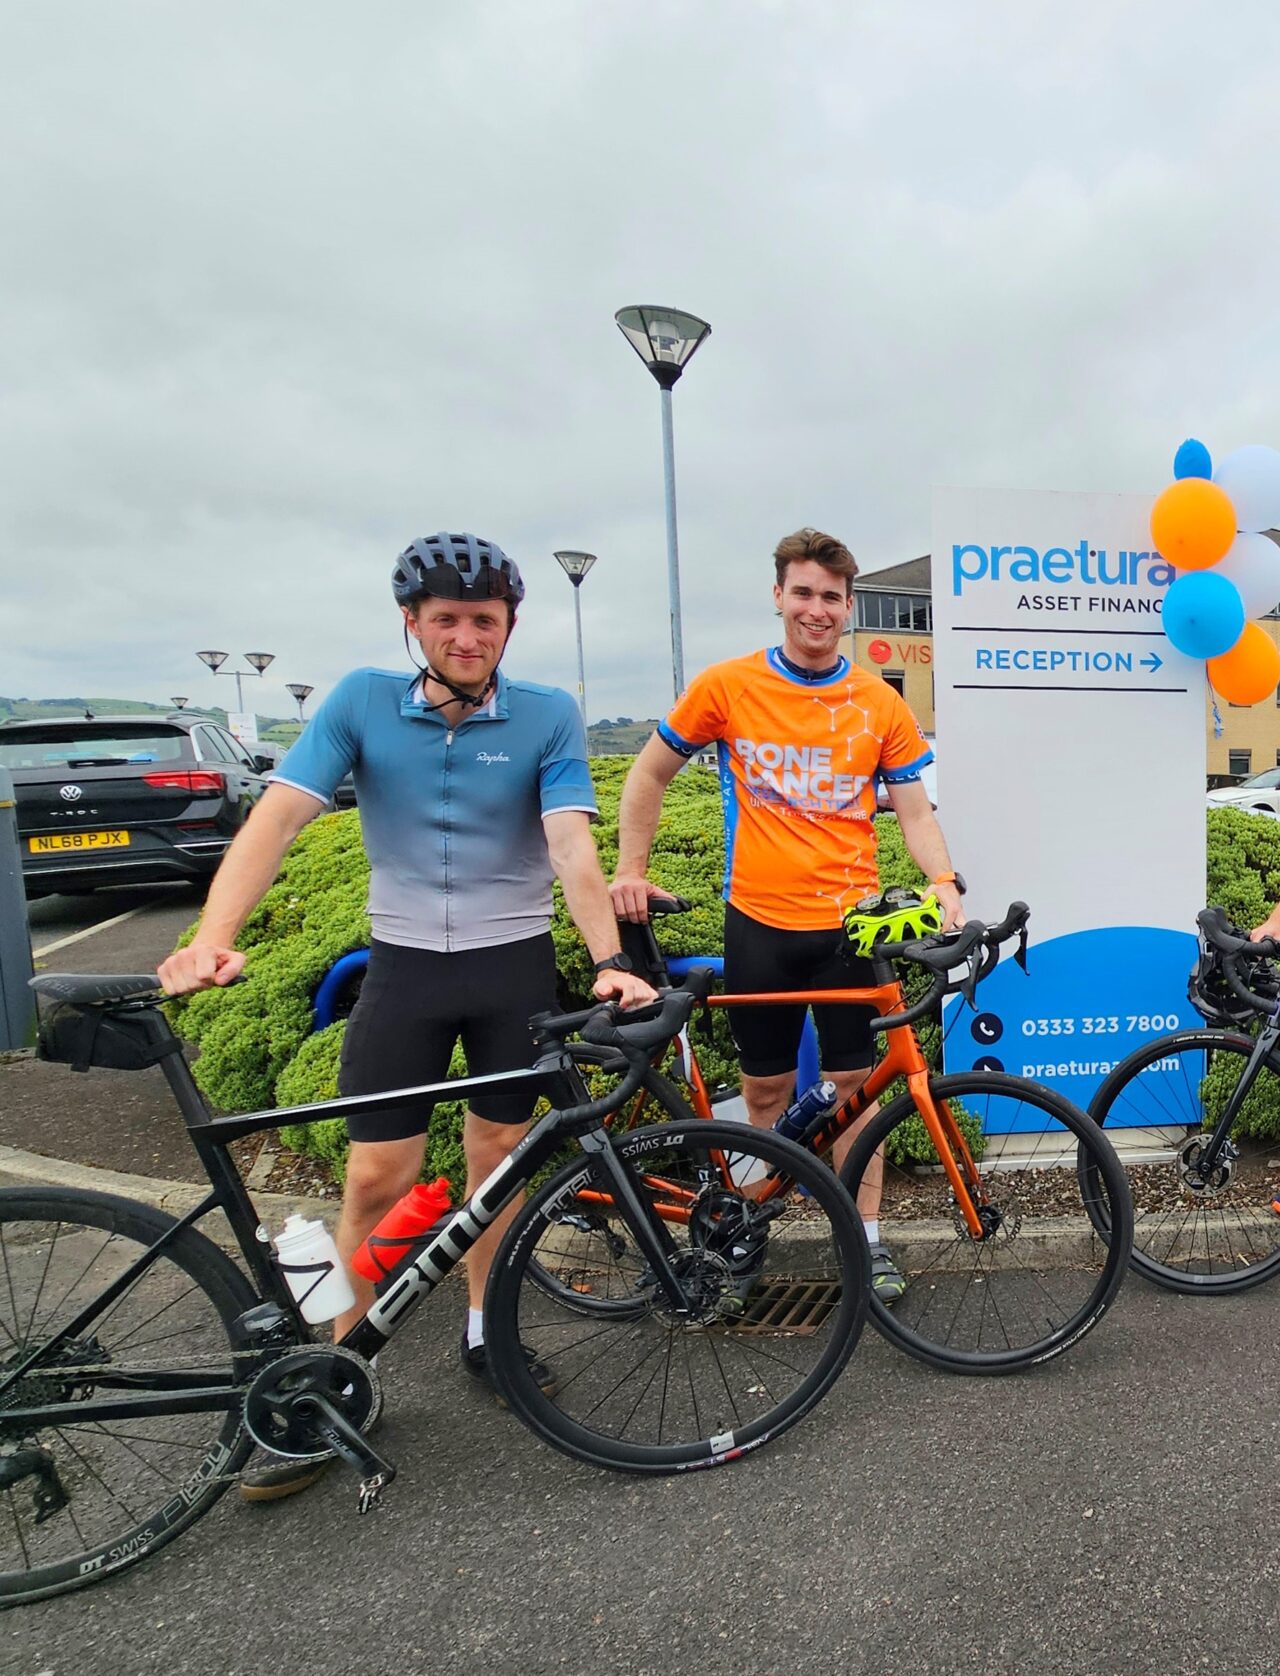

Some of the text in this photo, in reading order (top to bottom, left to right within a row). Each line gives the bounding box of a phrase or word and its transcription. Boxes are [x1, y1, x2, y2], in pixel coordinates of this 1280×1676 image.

[952, 540, 1177, 596] praetura
[1017, 595, 1163, 613] ASSET FINANC
[976, 649, 1133, 672] RECEPTION
[476, 751, 511, 766] Rapha
[735, 738, 833, 772] BONE
[38, 832, 122, 849] NL68 PJX
[1021, 1014, 1179, 1036] 0333 323 7800
[366, 1154, 514, 1337] BMC
[79, 1554, 105, 1575] DT
[108, 1528, 155, 1562] SWISS
